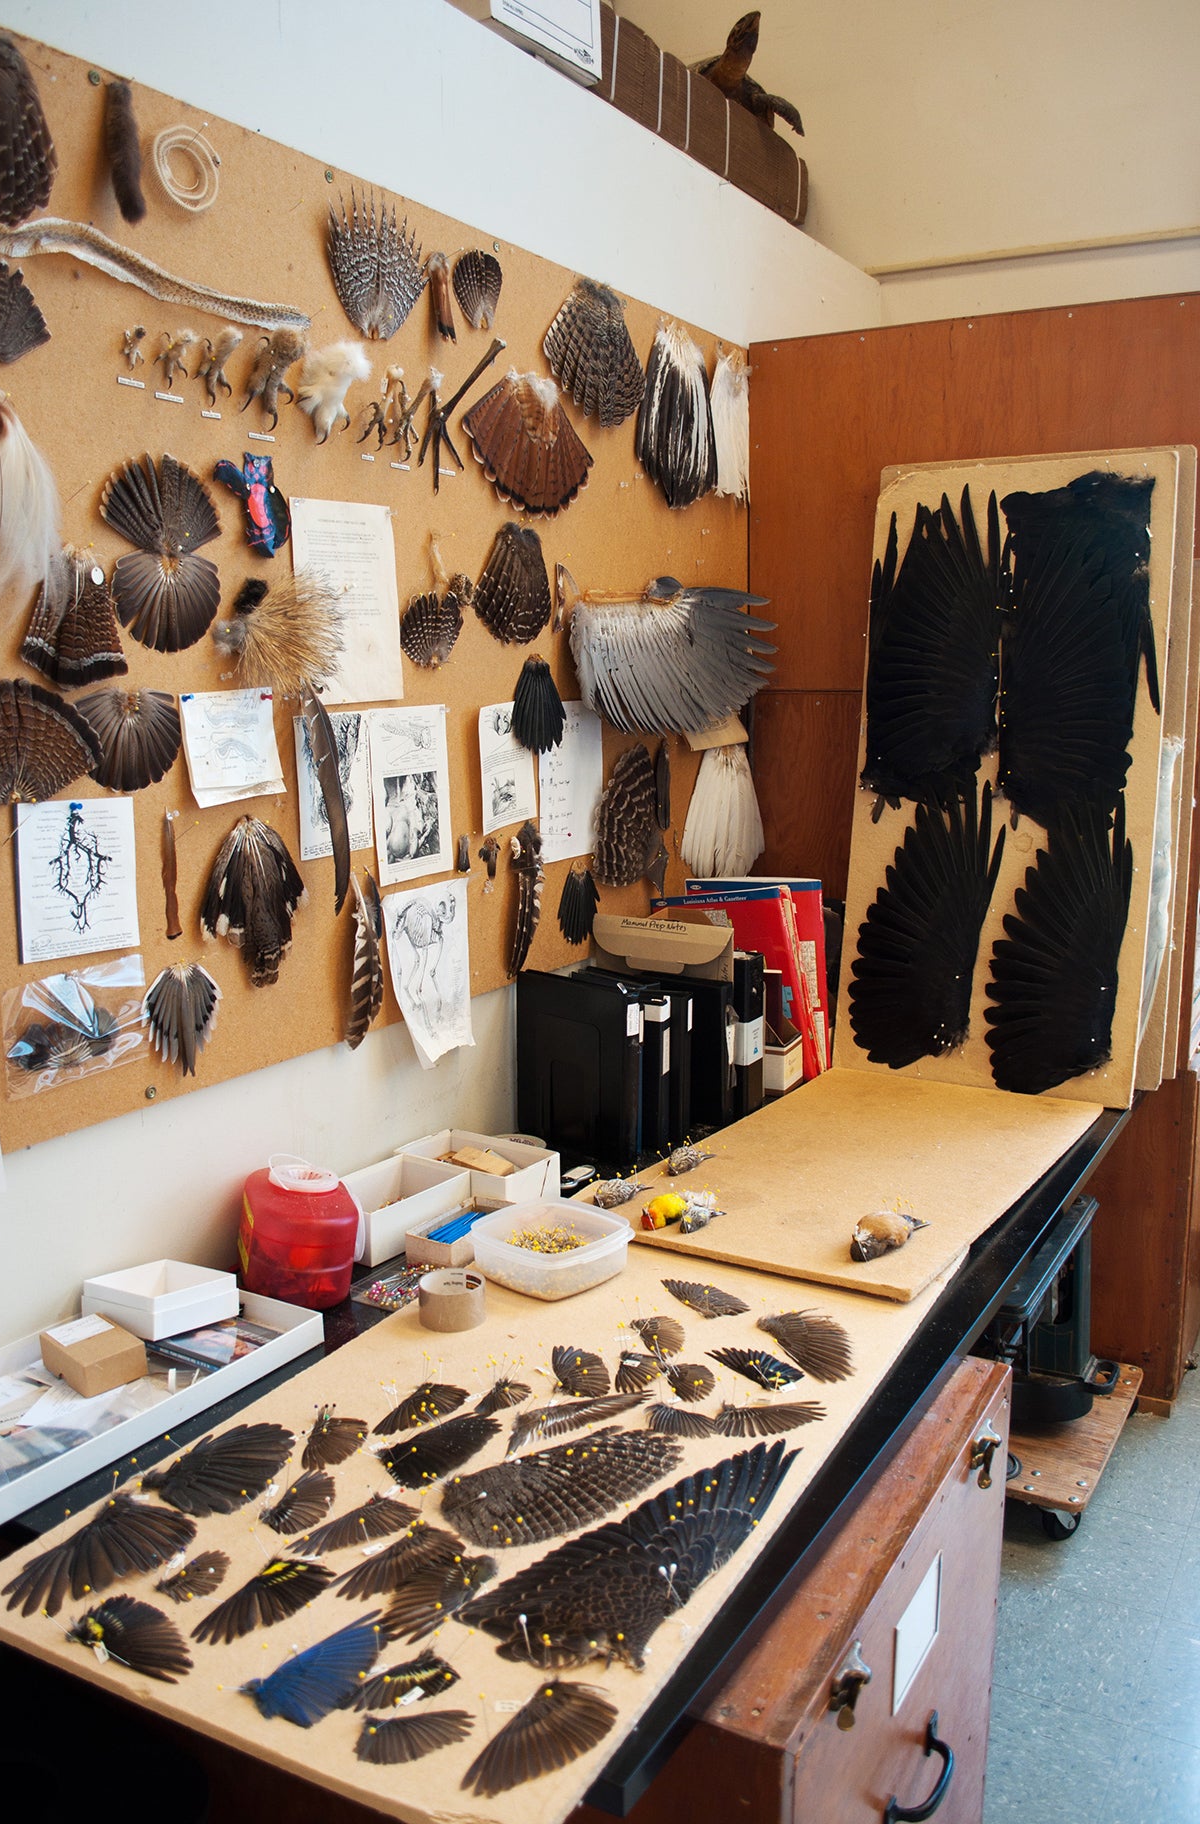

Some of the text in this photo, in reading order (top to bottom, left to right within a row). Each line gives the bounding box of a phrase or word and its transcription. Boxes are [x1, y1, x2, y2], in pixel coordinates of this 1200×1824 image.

[621, 918, 687, 932] Mammal Prep Notes
